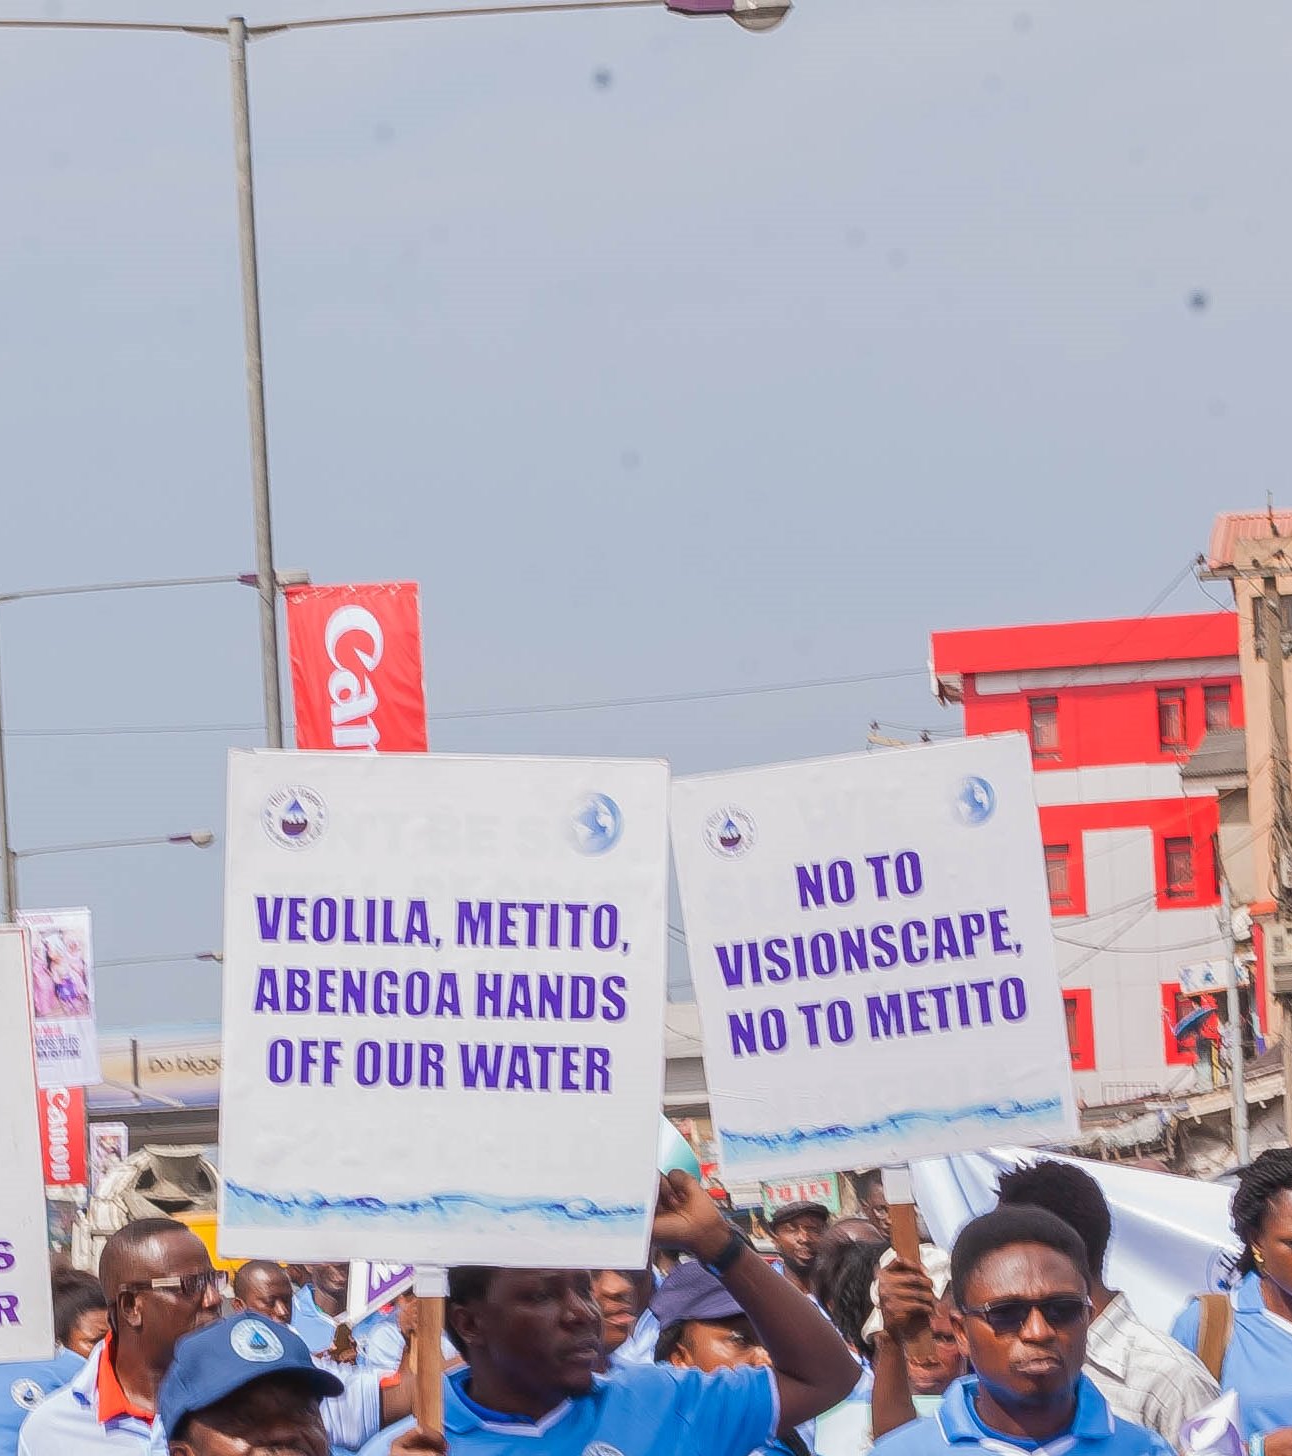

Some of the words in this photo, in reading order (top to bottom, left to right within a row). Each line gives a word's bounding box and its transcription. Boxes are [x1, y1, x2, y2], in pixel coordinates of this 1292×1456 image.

[795, 859, 855, 909] NO
[865, 850, 923, 899] TO
[255, 895, 440, 949] VEOLILA,
[455, 899, 629, 953] METITO,
[714, 908, 1022, 987] VISIONSCAPE,
[254, 967, 462, 1017] ABENGOA
[476, 971, 627, 1021] HANDS
[727, 1008, 788, 1056] NO
[798, 1000, 854, 1047] TO
[865, 976, 1027, 1039] METITO
[269, 1038, 341, 1083] OFF
[357, 1040, 444, 1087] OUR
[459, 1043, 610, 1092] WATER
[47, 1087, 70, 1181] Canon
